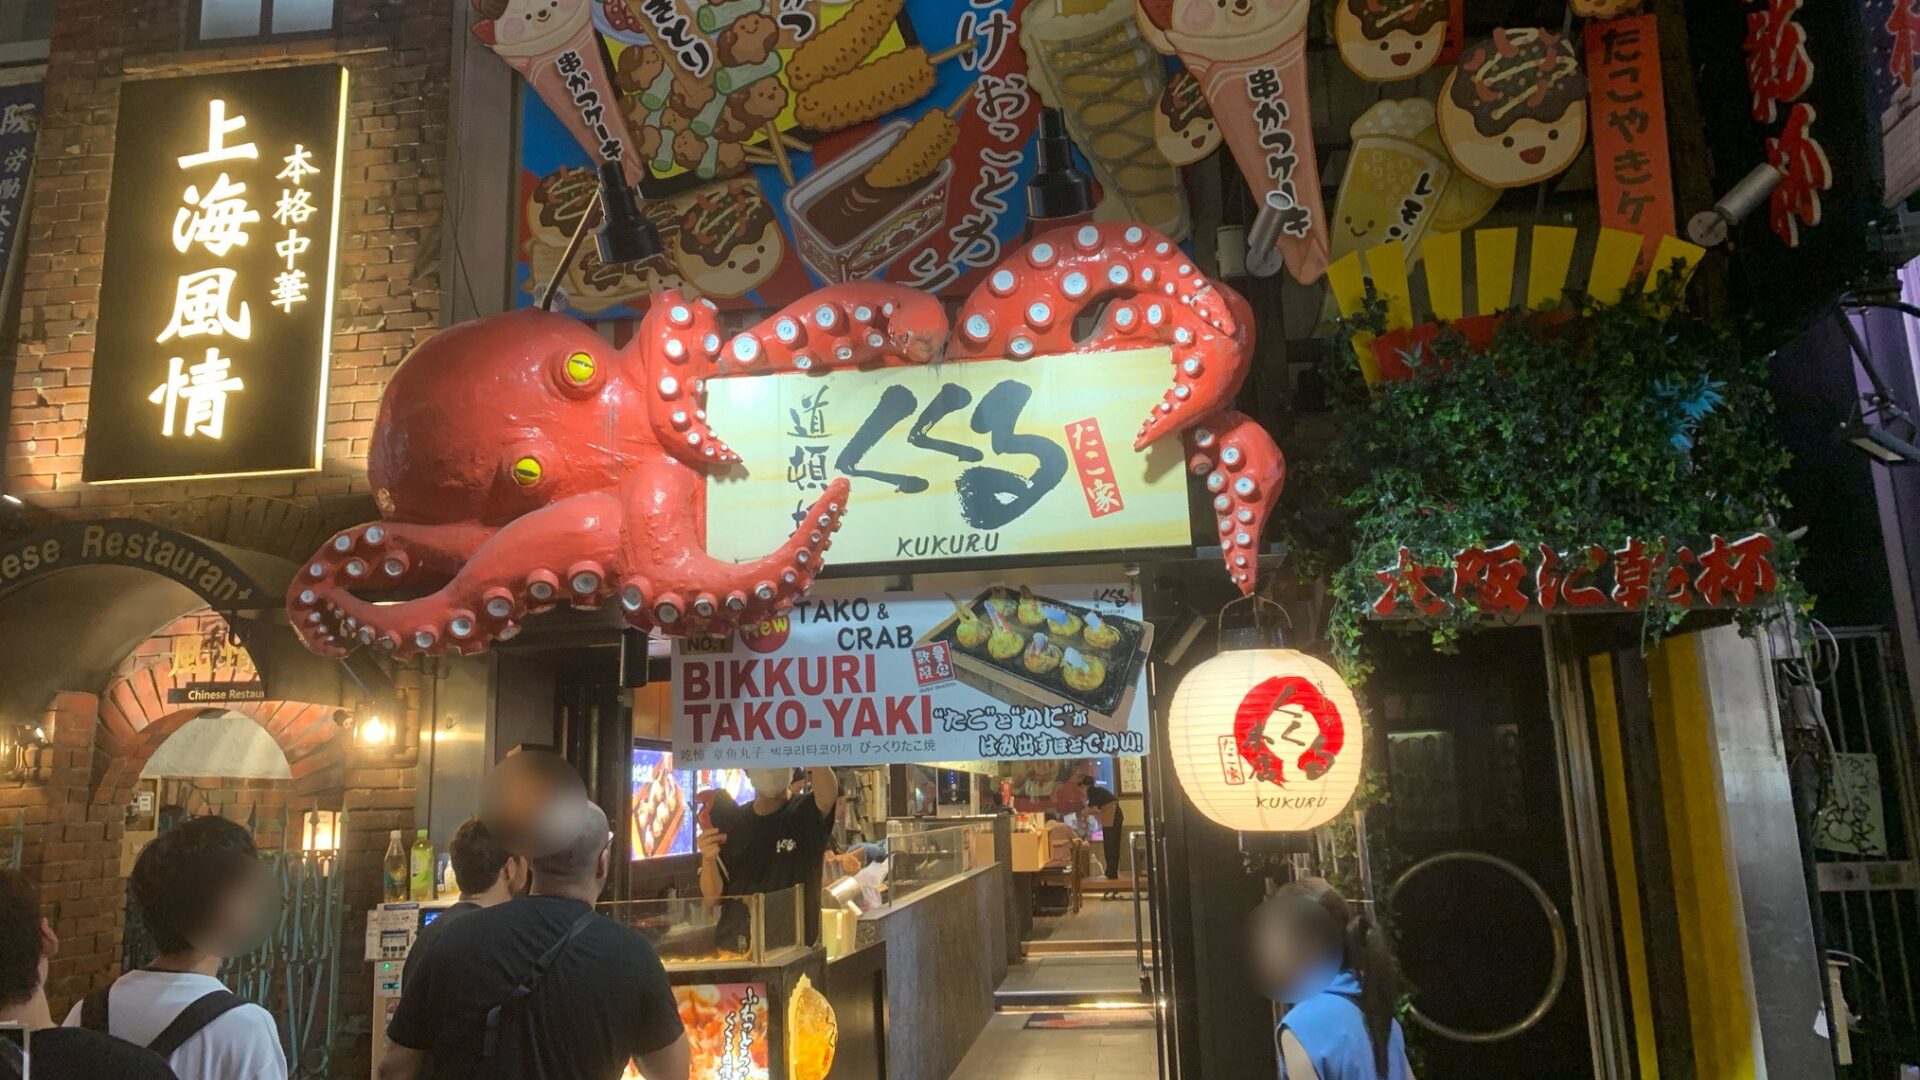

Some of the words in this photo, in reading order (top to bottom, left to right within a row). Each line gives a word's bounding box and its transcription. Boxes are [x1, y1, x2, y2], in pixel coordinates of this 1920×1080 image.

[556, 50, 623, 160] 串かつケーキ
[896, 0, 1027, 292] けおことわり
[1246, 66, 1311, 238] 串かつケーキ
[270, 144, 321, 314] 本格中華
[149, 99, 260, 440] 上海風情
[834, 379, 1069, 530] くくる
[1072, 423, 1121, 514] たこ家
[0, 538, 61, 584] ese
[896, 533, 1000, 558] KUKURU
[1374, 533, 1776, 614] 大阪に乾杯
[793, 597, 870, 624] TAKO
[877, 602, 890, 620] &
[688, 638, 726, 651] NO.1
[837, 624, 914, 651] CRAB
[188, 689, 227, 701] Chinese
[683, 654, 877, 701] BIKKURI
[683, 694, 933, 743] TAKO-YAKI
[859, 739, 937, 754] びっくりたこ焼
[1256, 796, 1328, 809] KUKURU
